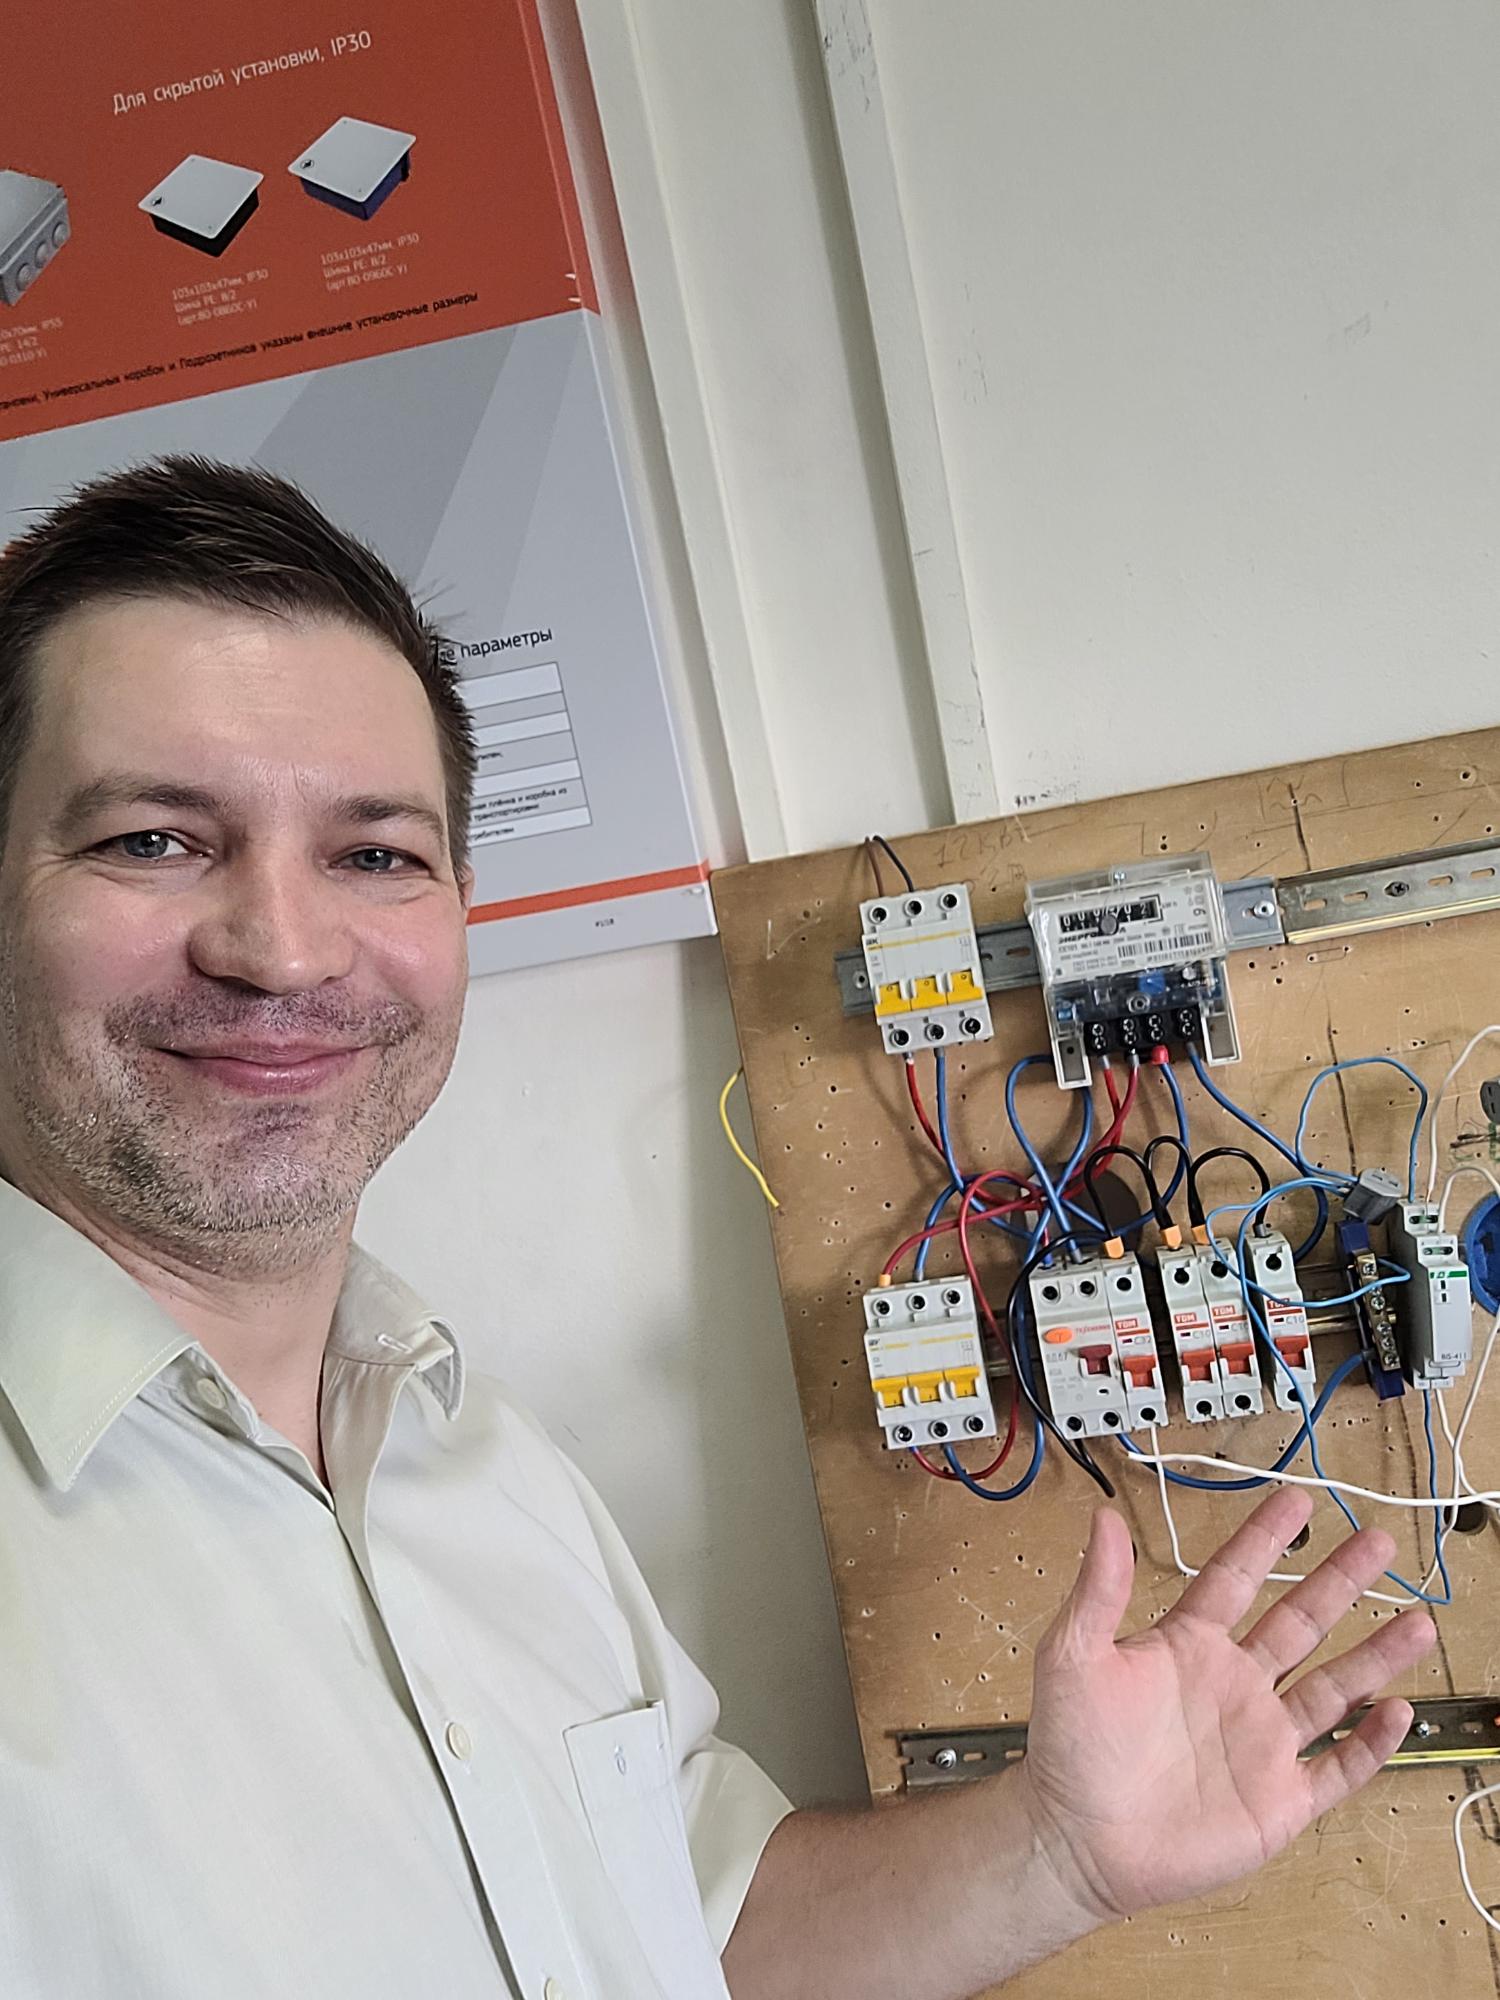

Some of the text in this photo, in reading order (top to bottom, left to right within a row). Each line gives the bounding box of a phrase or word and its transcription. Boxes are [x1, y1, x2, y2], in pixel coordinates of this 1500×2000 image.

[113, 30, 372, 115] Для скрытой установки, IP30
[168, 361, 177, 371] и
[261, 332, 304, 352] указаны
[307, 321, 352, 339] внешние
[356, 303, 428, 330] установочные
[433, 292, 478, 312] размеры
[460, 628, 553, 658] параметры
